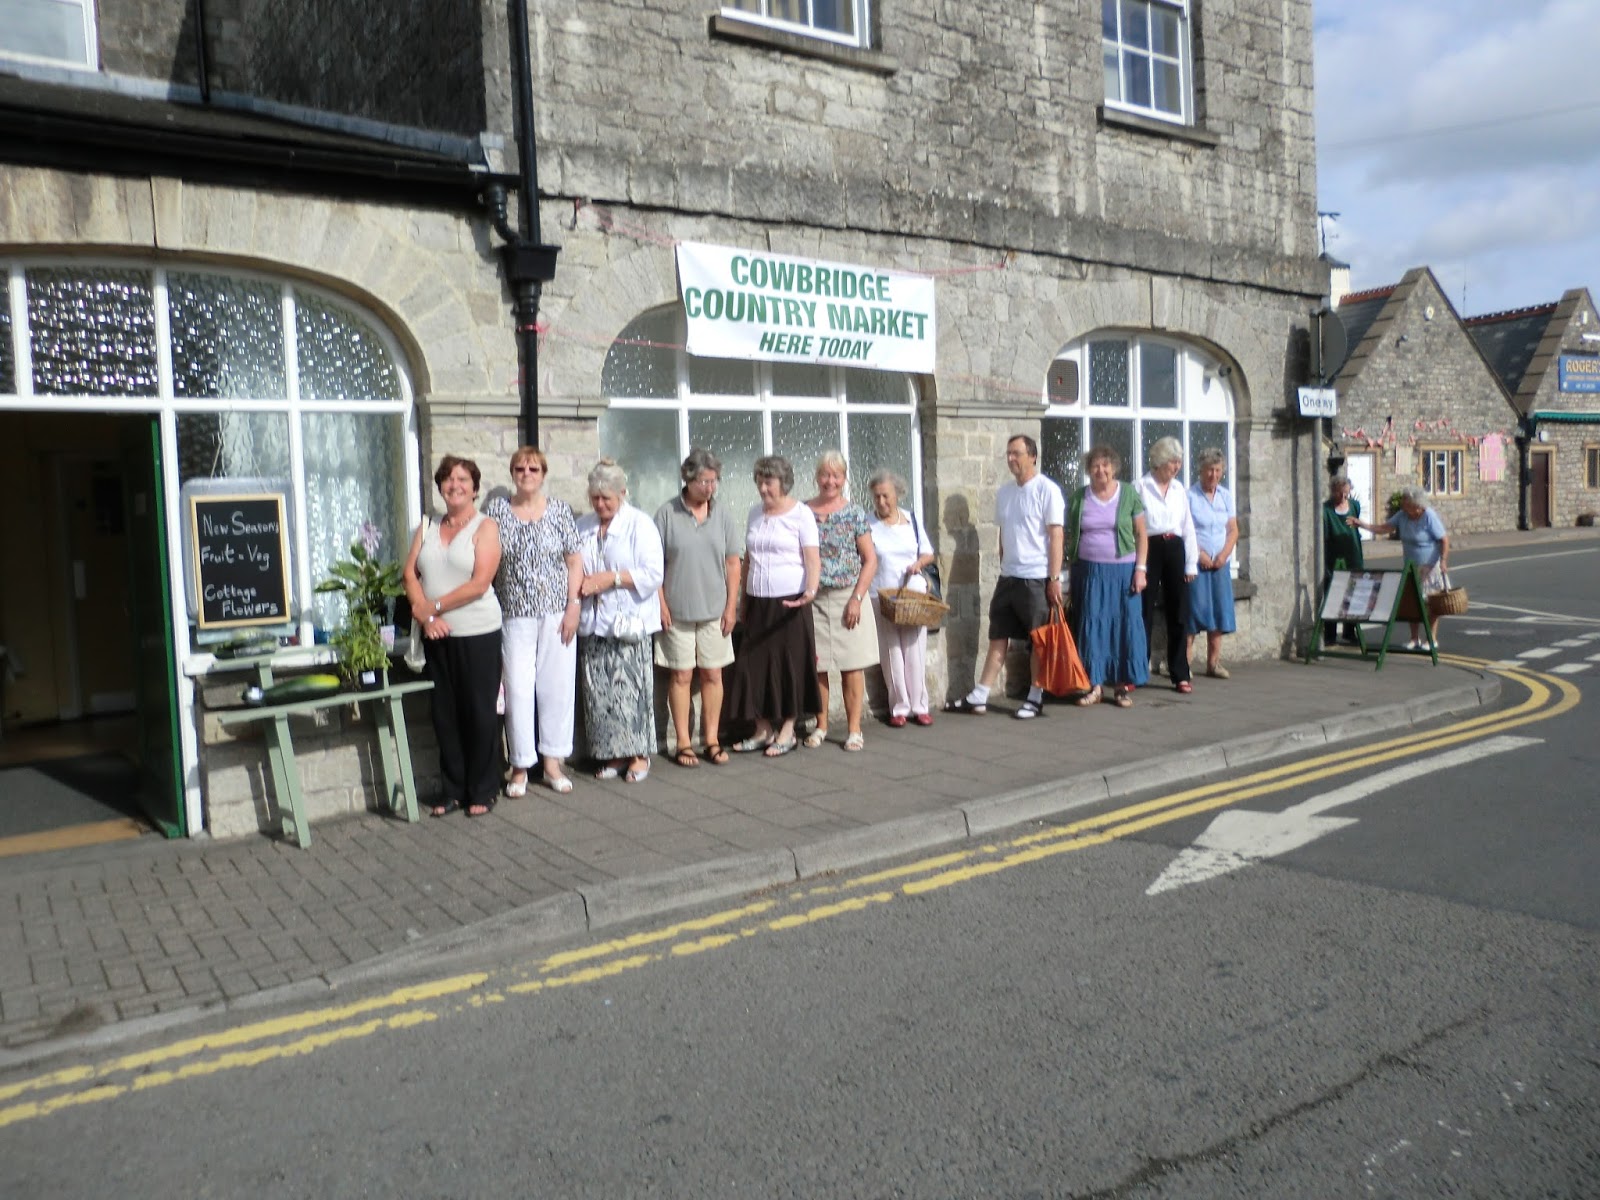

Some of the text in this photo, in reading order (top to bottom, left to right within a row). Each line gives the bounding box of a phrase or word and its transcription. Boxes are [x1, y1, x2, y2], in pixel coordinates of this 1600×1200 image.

[730, 255, 892, 302] COWBRIDGE
[685, 286, 928, 340] COUNTRY MARKET
[758, 332, 873, 360] HERE TODAY
[203, 513, 229, 537] New
[201, 543, 270, 572] Fruit Veg
[204, 583, 257, 604] Cottage
[222, 600, 279, 619] Flowers
